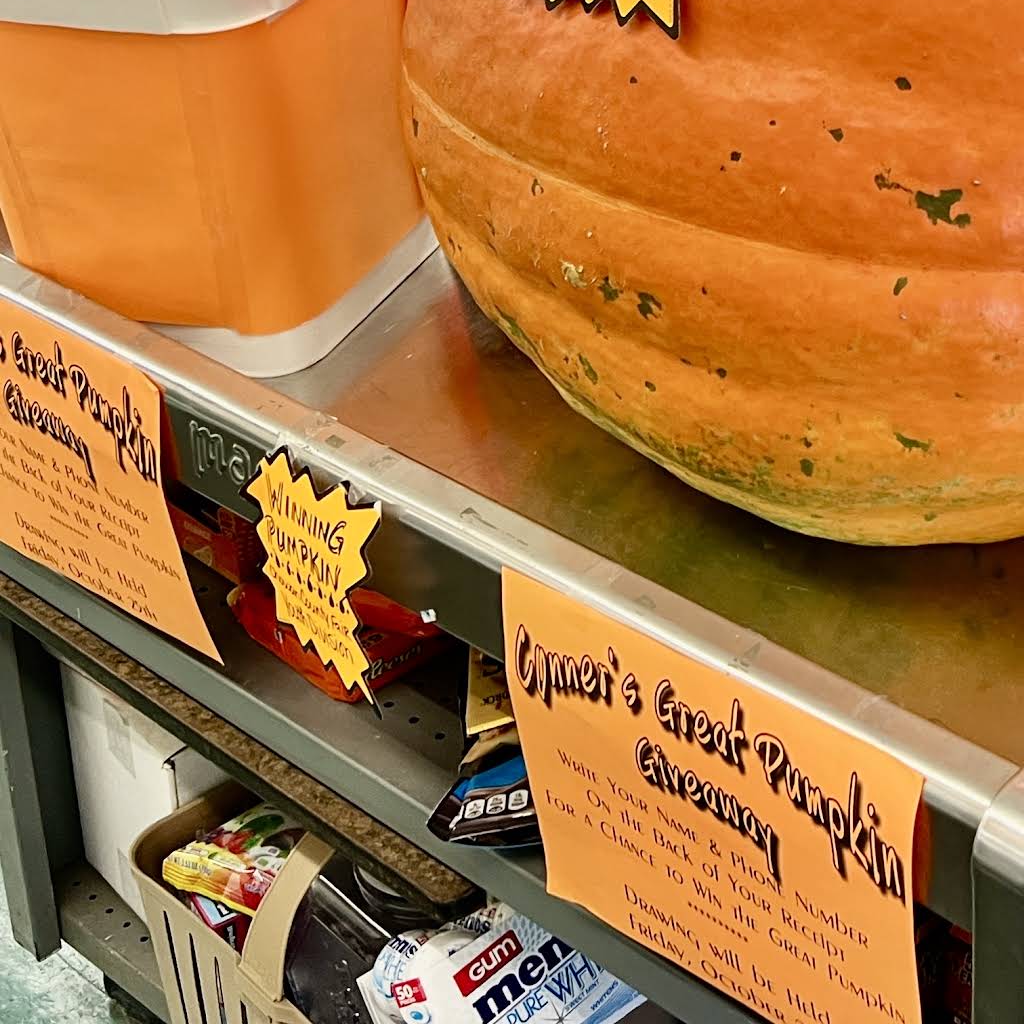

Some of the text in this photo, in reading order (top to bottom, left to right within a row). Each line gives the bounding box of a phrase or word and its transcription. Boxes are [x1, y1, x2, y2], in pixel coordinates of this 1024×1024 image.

[4, 378, 94, 480] Giveaway
[12, 331, 158, 484] Great Pumpkin
[264, 514, 342, 592] PUMPKIN
[265, 472, 347, 556] WINNING
[514, 623, 640, 710] Conner's
[655, 678, 747, 767] Great
[753, 732, 906, 899] Pumpkin
[635, 736, 777, 876] Giveaway
[709, 839, 722, 858] &
[395, 984, 414, 1002] 50
[506, 986, 549, 1024] PURE
